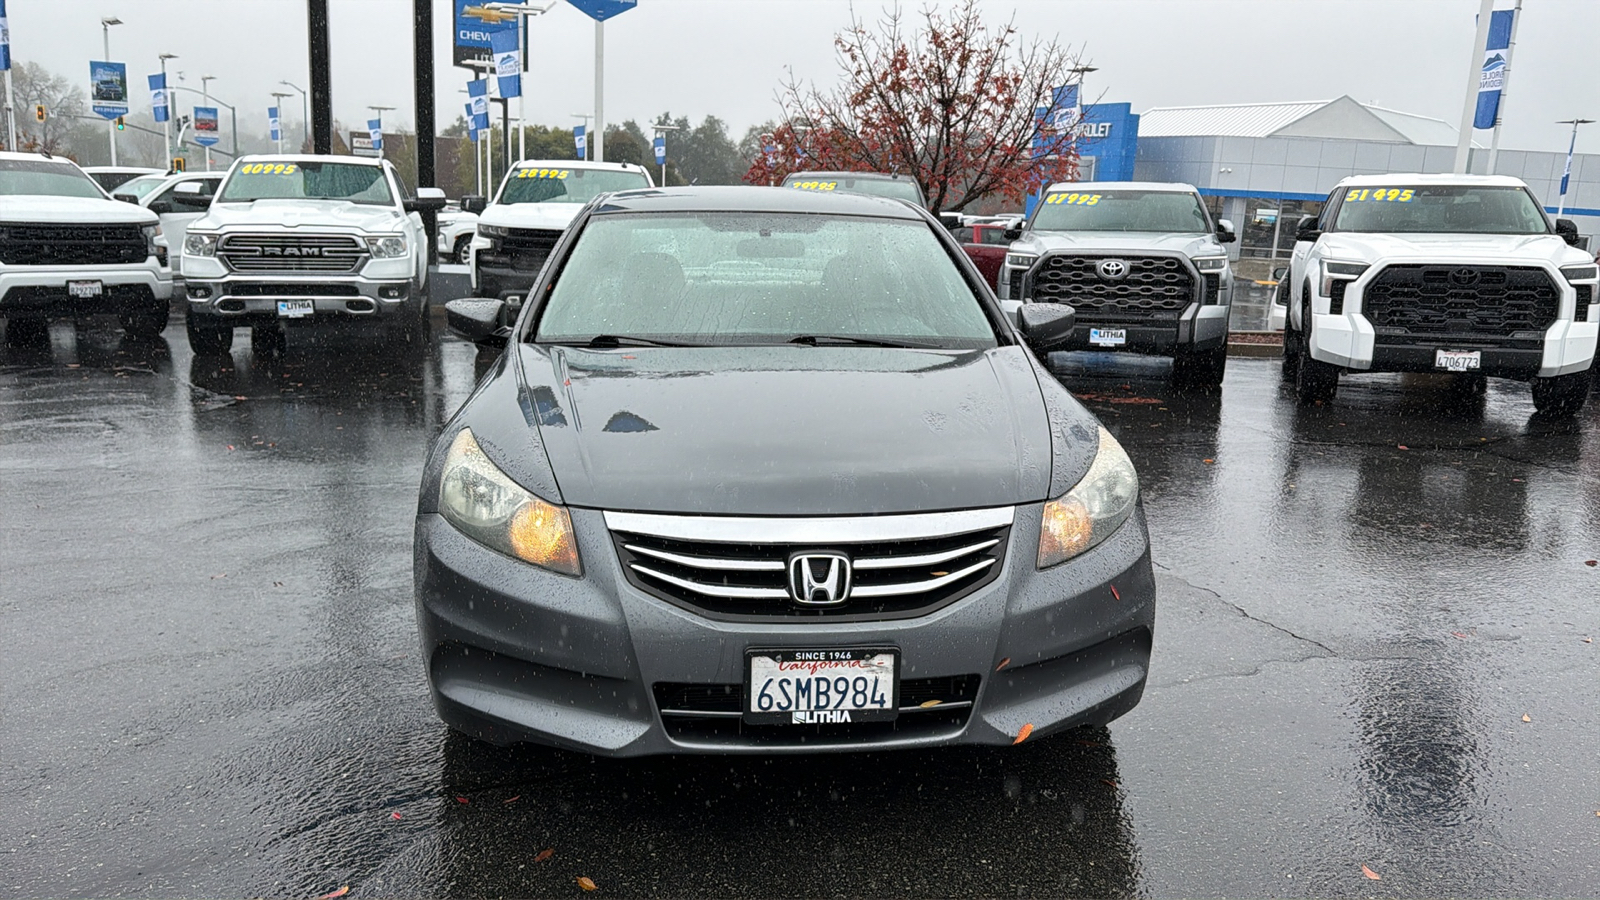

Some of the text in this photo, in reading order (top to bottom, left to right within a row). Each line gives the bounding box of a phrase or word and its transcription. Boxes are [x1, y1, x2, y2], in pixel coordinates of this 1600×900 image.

[241, 162, 298, 175] 40995
[517, 167, 570, 180] 28995
[1046, 192, 1103, 206] 47995
[1345, 188, 1415, 202] 51 495
[263, 246, 320, 257] RAM
[285, 301, 312, 310] LITHIA
[1098, 330, 1124, 339] LITHIA
[795, 651, 852, 661] SINCE 1946
[778, 660, 870, 675] California
[757, 677, 887, 711] 6SMB984
[806, 711, 852, 725] LITHIA
